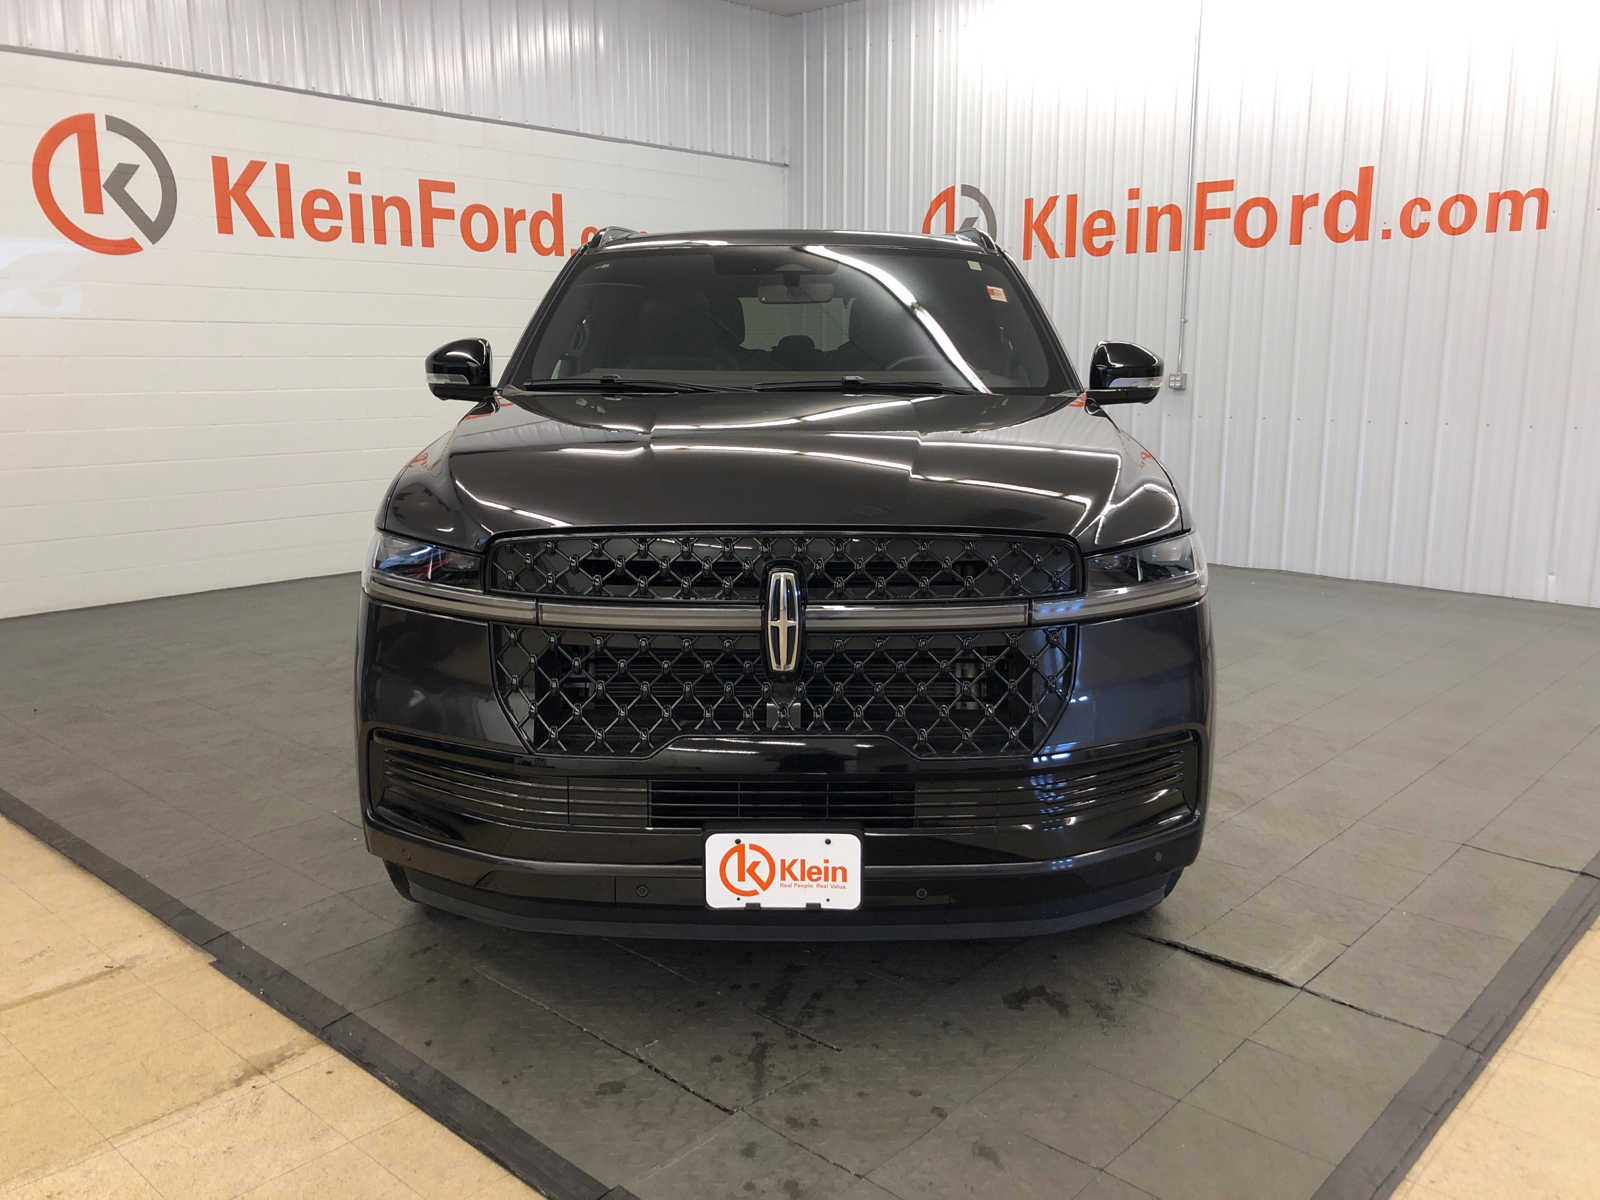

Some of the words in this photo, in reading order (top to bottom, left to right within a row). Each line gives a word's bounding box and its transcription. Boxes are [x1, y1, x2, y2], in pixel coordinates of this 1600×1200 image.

[1022, 165, 1550, 261] KleinFord.com
[780, 858, 848, 883] Klein
[793, 882, 815, 890] People.
[830, 883, 848, 891] Value.
